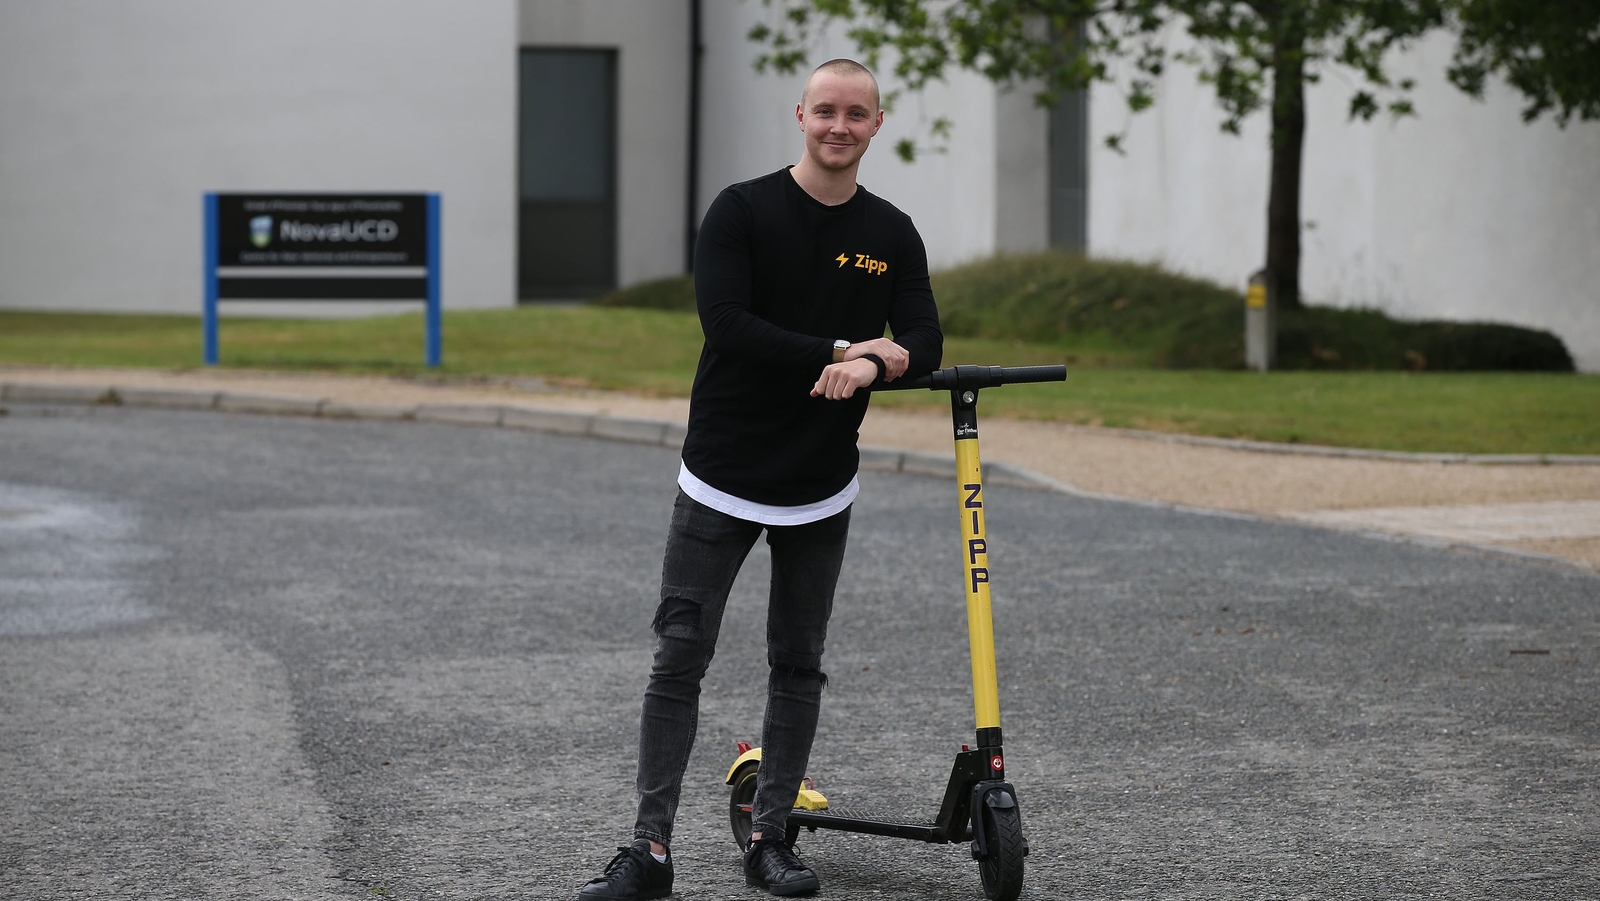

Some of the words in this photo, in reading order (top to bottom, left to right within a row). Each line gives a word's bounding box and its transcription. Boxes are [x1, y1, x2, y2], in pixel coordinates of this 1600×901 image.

[280, 219, 399, 242] NovaUCD
[854, 253, 888, 275] Zipp
[964, 484, 989, 593] ZIPP
